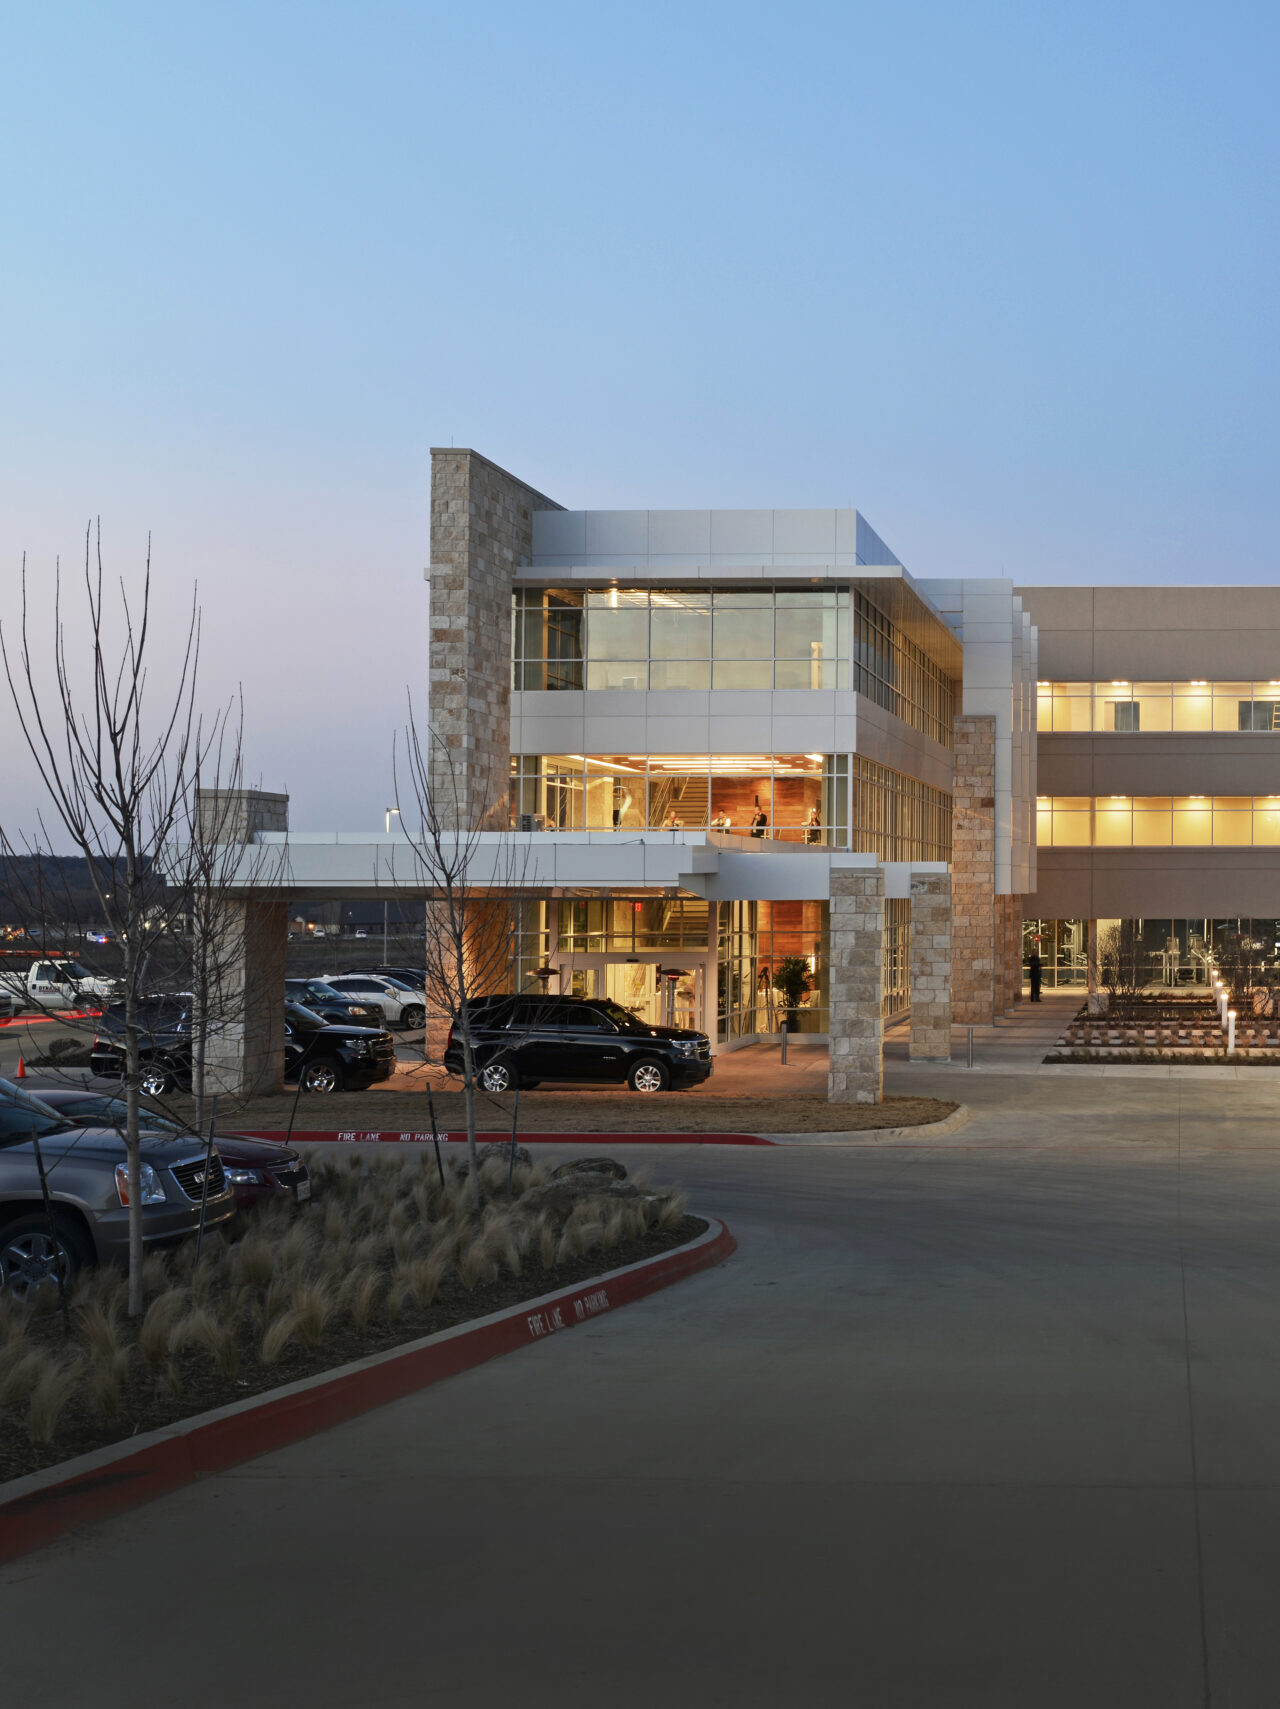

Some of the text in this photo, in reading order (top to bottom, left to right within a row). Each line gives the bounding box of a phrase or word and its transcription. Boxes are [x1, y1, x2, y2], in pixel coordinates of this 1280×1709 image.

[337, 1132, 356, 1141] FIRE
[360, 1133, 381, 1141] LANE
[414, 1134, 449, 1142] PARKNG
